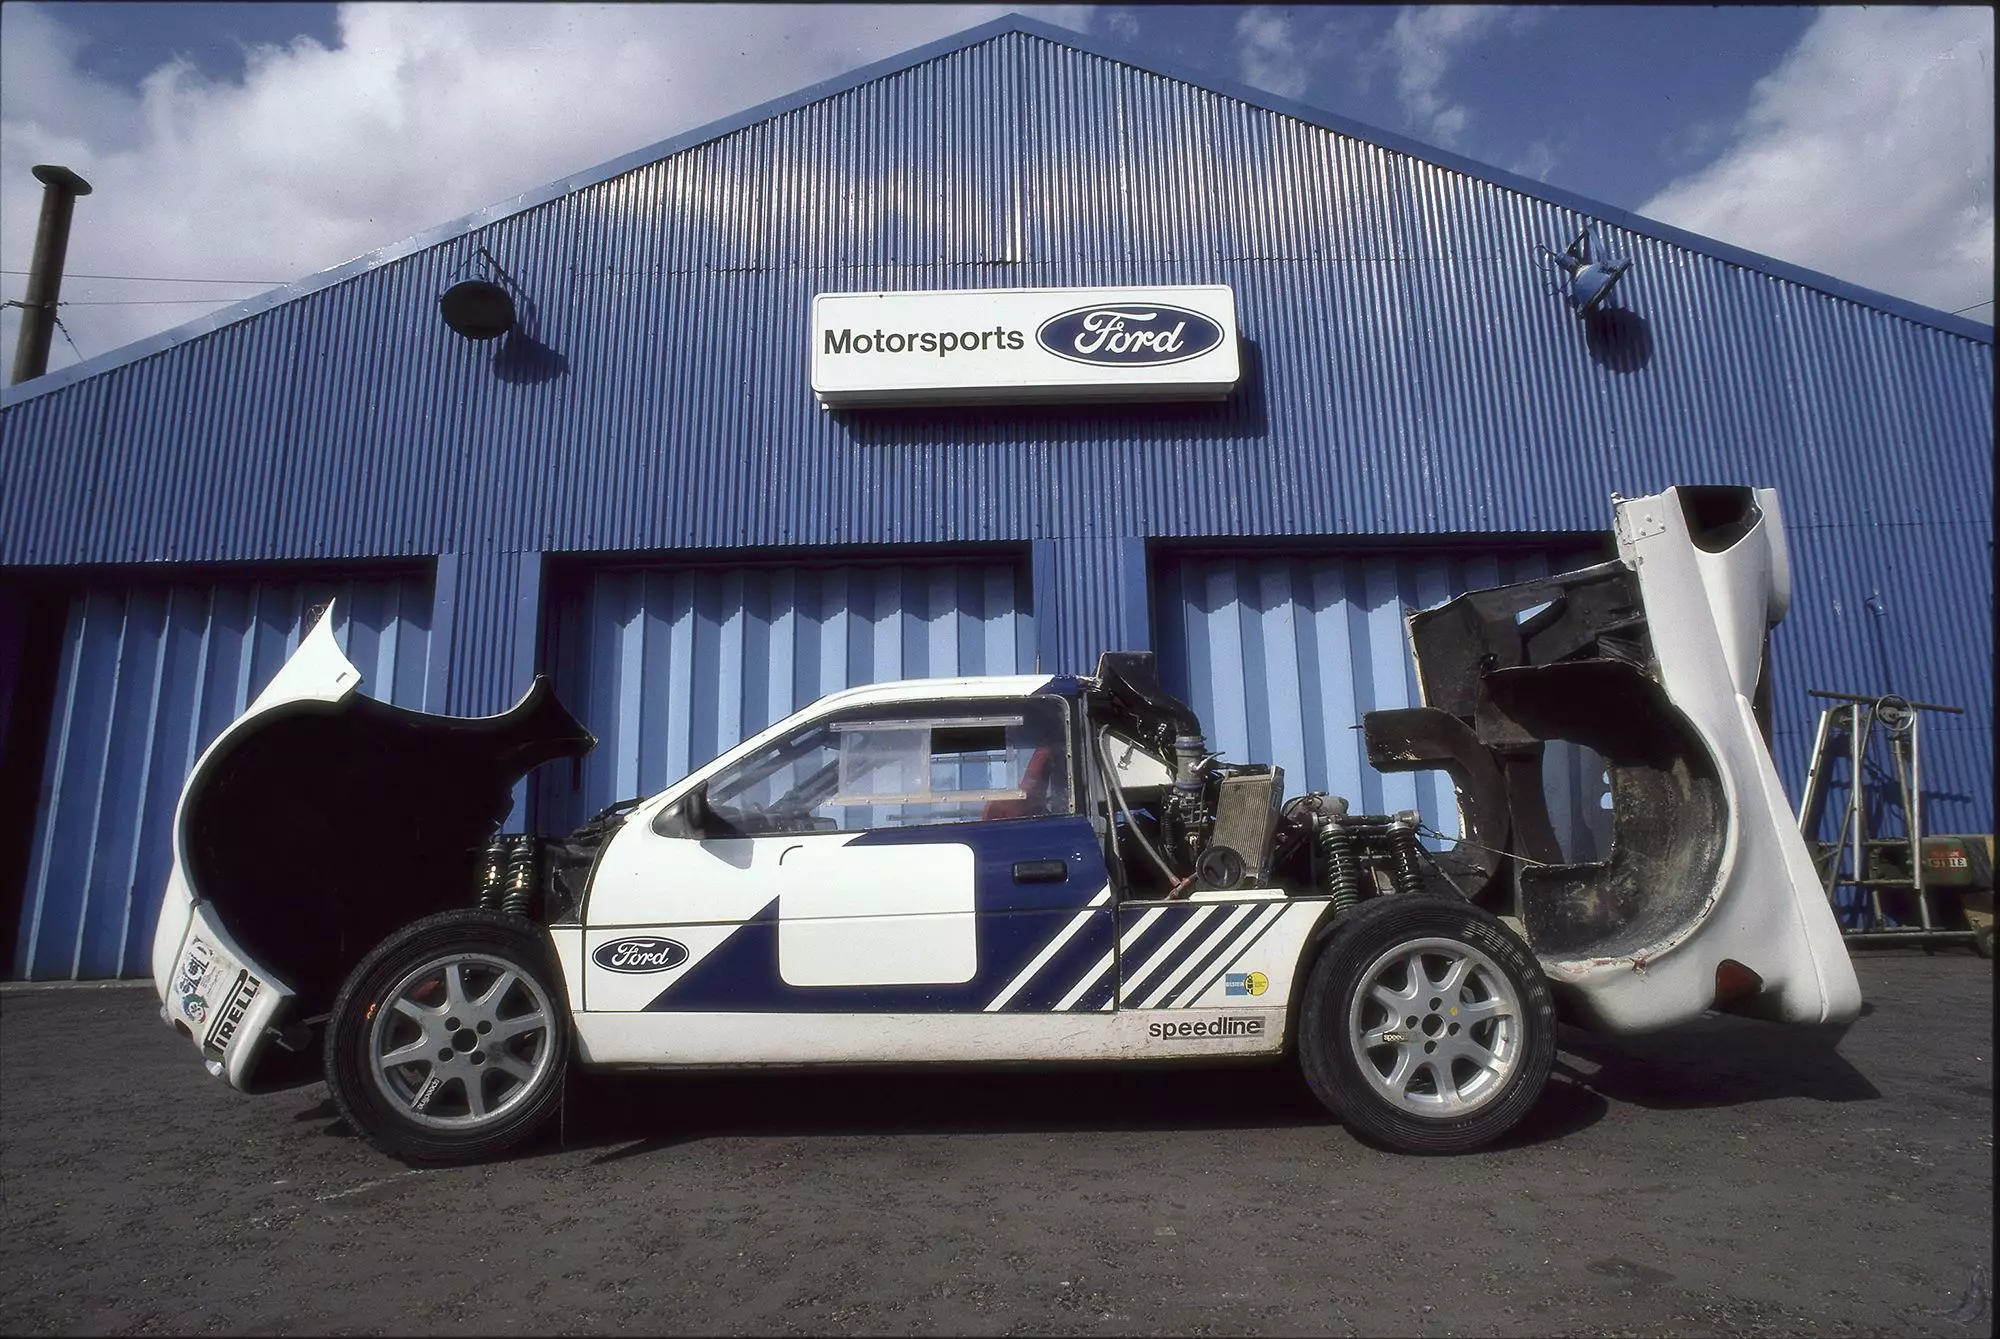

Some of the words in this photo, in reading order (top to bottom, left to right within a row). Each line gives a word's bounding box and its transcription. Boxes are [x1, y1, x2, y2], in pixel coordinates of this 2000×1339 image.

[824, 325, 1024, 357] Motorsports
[1074, 310, 1187, 355] Ford
[611, 942, 670, 966] Ford
[203, 968, 261, 1054] PIRELLI
[1149, 1016, 1261, 1040] speedline
